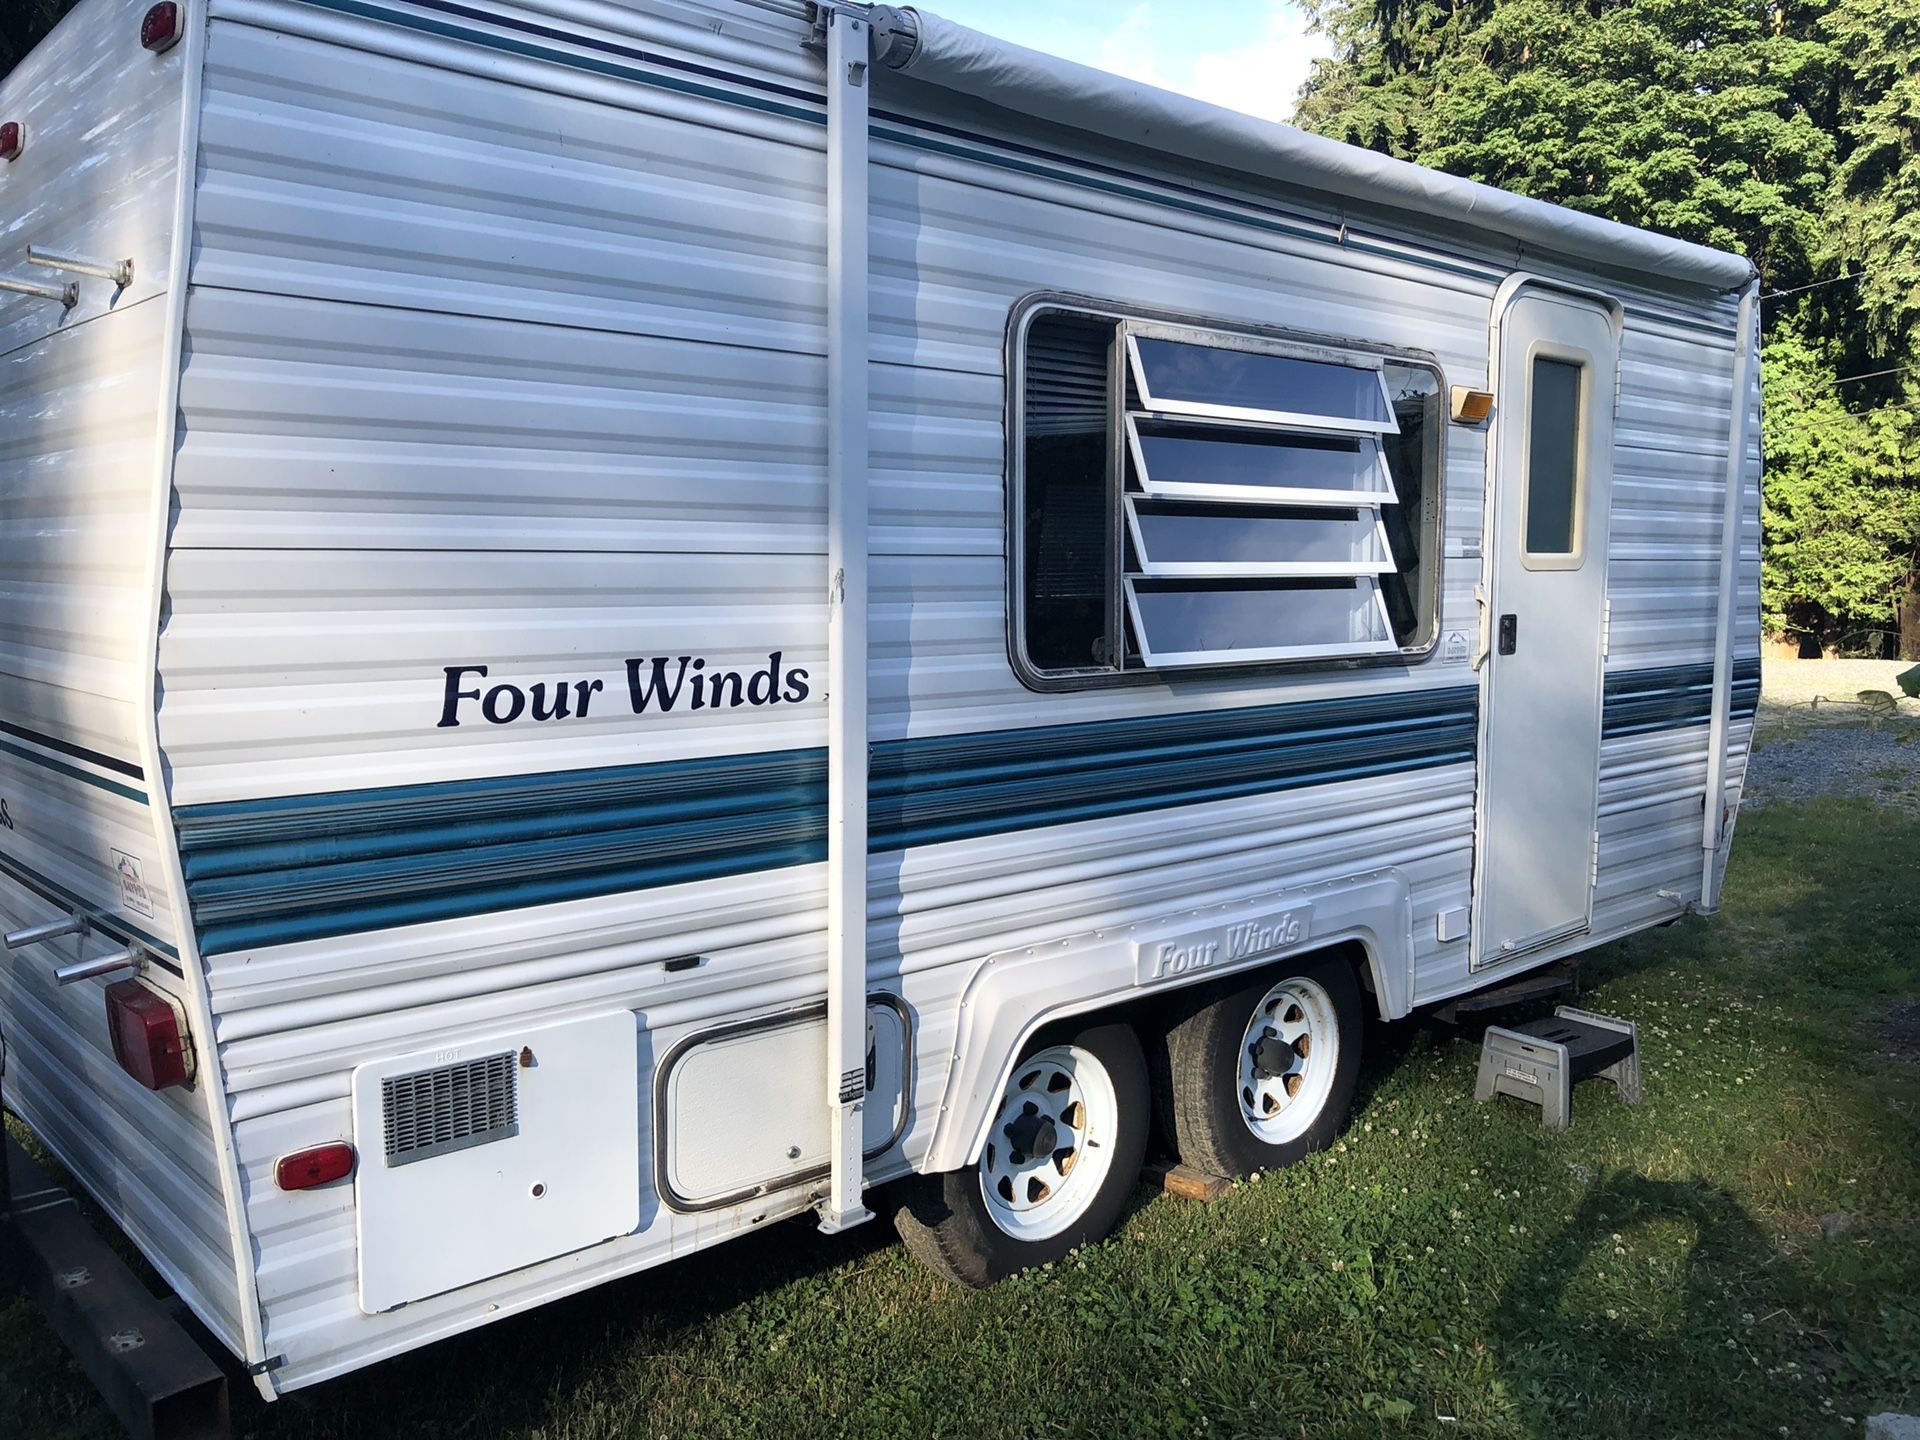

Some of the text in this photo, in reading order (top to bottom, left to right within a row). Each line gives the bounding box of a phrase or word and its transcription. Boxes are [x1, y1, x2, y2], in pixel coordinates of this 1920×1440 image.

[437, 651, 810, 728] Four Winds
[1152, 913, 1300, 979] Four Winds
[435, 1048, 461, 1063] HOT
